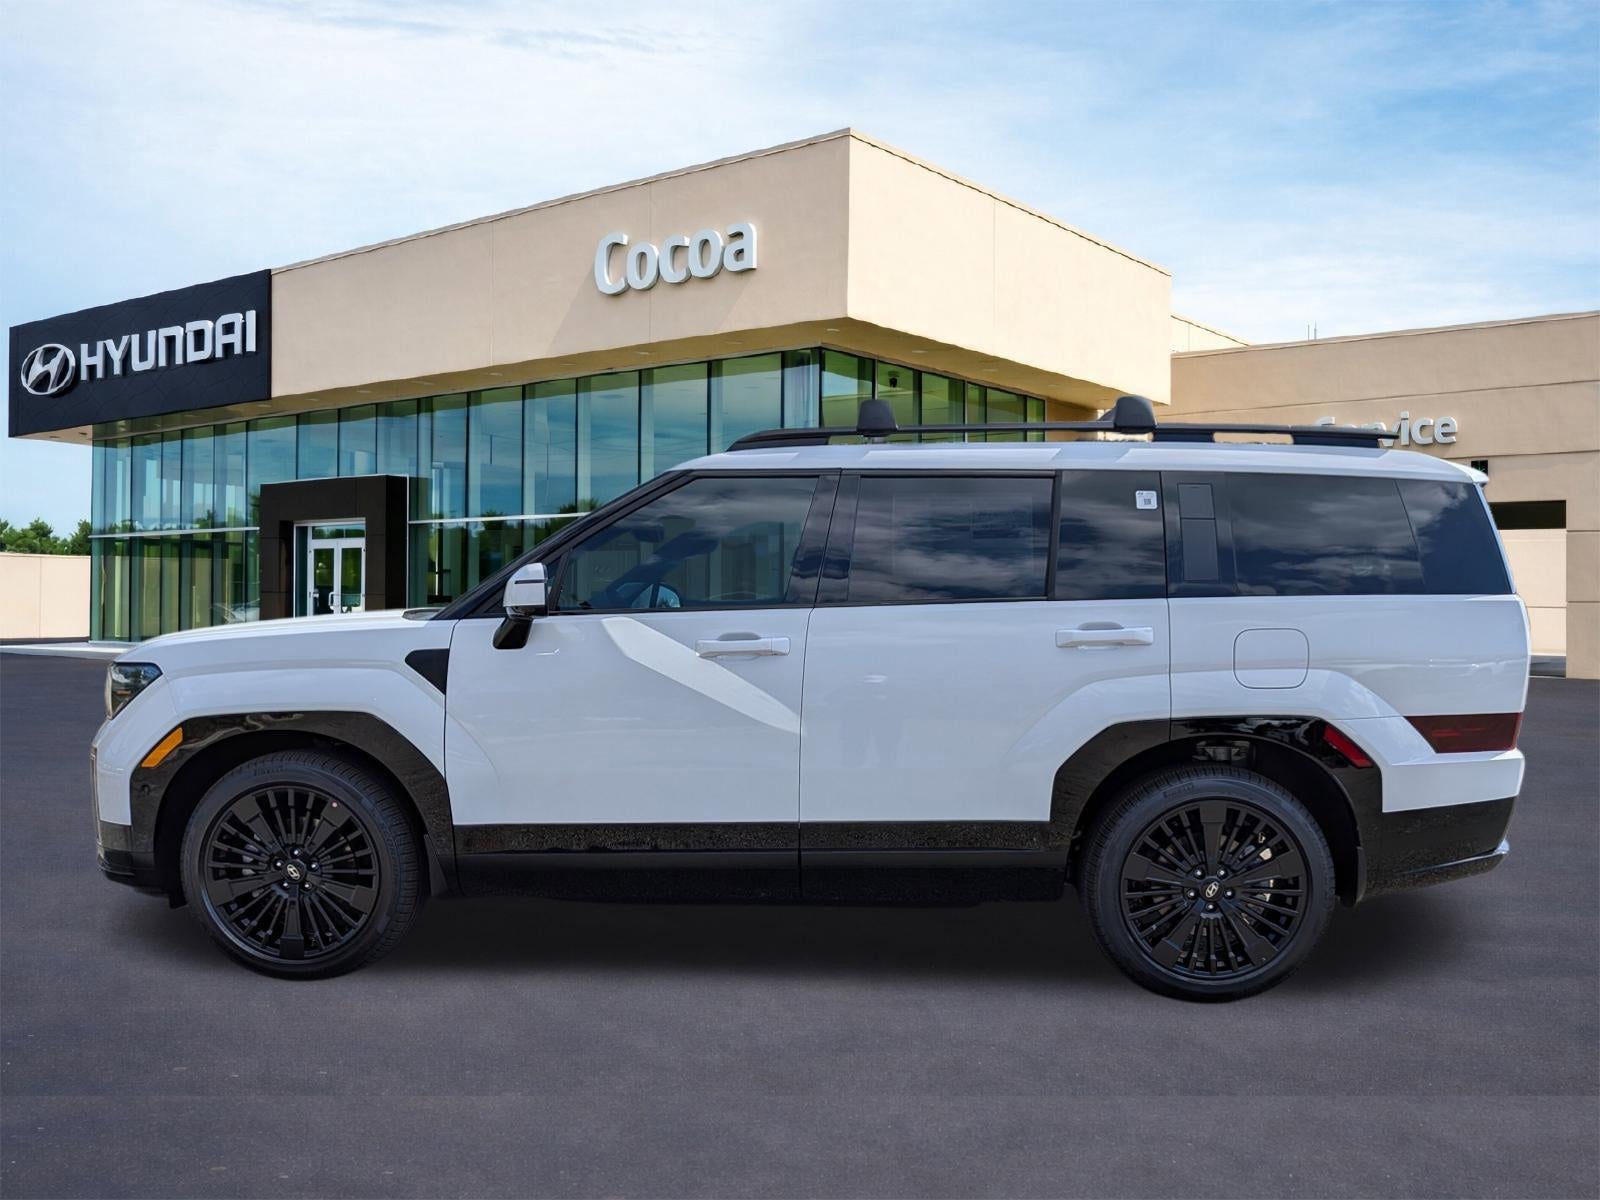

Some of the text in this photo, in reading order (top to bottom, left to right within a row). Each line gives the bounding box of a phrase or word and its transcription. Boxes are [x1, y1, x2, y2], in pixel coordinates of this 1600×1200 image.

[594, 222, 758, 295] Cocoa
[80, 309, 256, 382] HYUNDAI
[1312, 410, 1458, 447] vice
